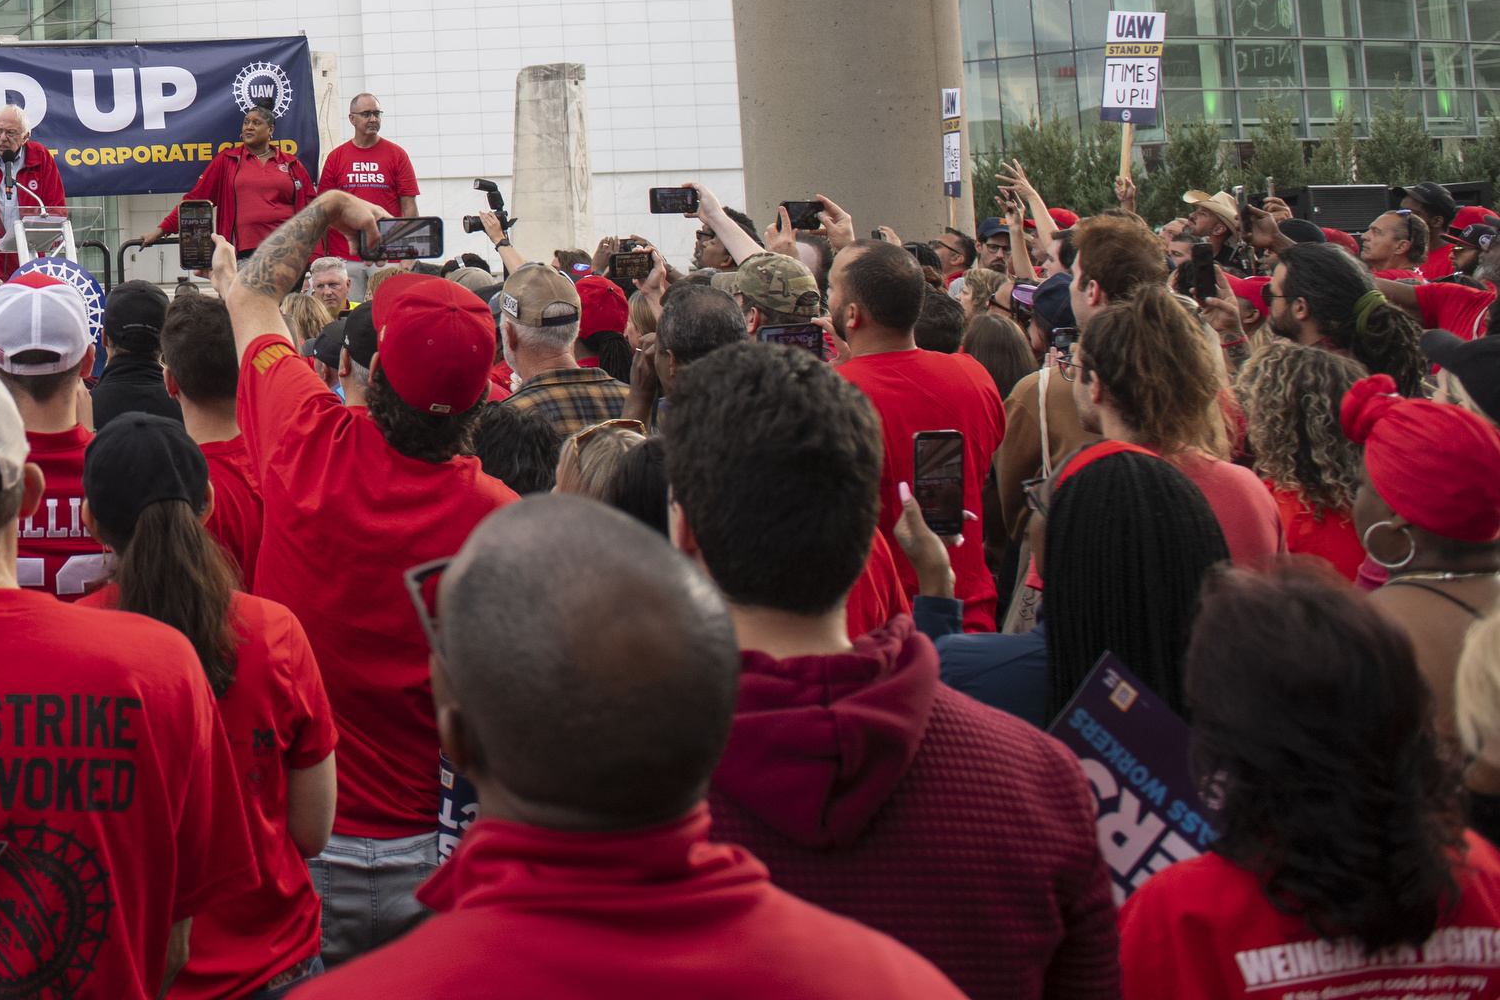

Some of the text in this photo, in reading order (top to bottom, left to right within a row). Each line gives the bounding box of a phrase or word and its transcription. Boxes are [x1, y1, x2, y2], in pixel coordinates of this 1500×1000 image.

[1116, 15, 1155, 39] UAW
[1108, 45, 1159, 55] STAND UP
[1107, 62, 1156, 83] TIME'S
[71, 66, 197, 132] UP
[250, 83, 275, 99] UAW
[1115, 88, 1149, 105] UP!!
[65, 143, 212, 167] CORPORATE
[352, 162, 379, 172] END
[346, 173, 385, 183] TIERS
